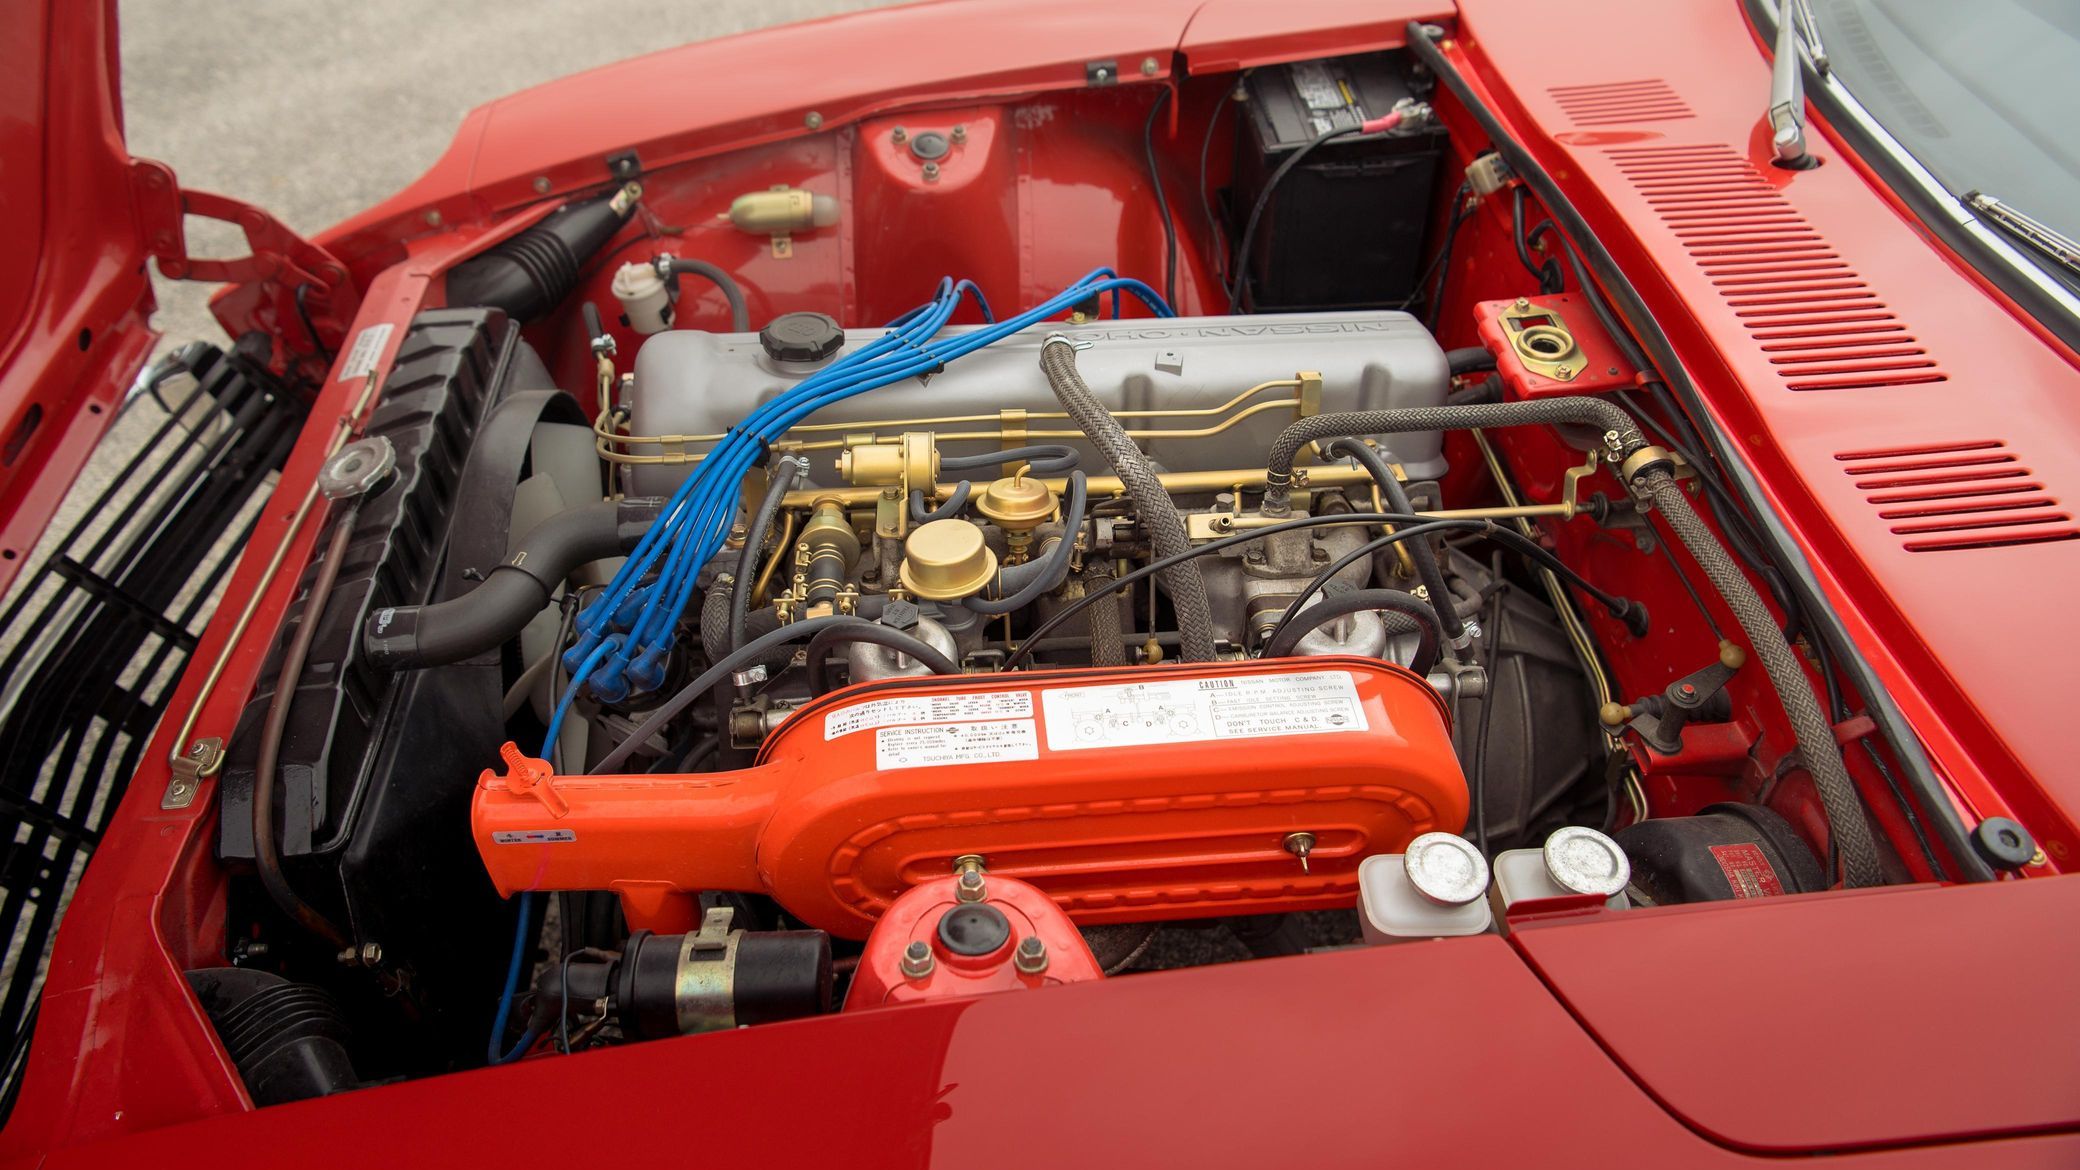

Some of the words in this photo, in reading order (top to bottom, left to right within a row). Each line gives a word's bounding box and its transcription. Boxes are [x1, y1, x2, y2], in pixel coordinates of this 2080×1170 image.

[1073, 330, 1173, 341] OHC
[1198, 322, 1389, 338] NISSAN
[1199, 679, 1235, 689] CAUTION
[1226, 719, 1251, 727] DON'T
[1260, 717, 1287, 725] TOUCH
[880, 730, 902, 738] SERVICE
[904, 727, 944, 735] INSTRUCTION
[1247, 726, 1281, 734] SERVICE
[1741, 849, 1766, 883] MASTER
